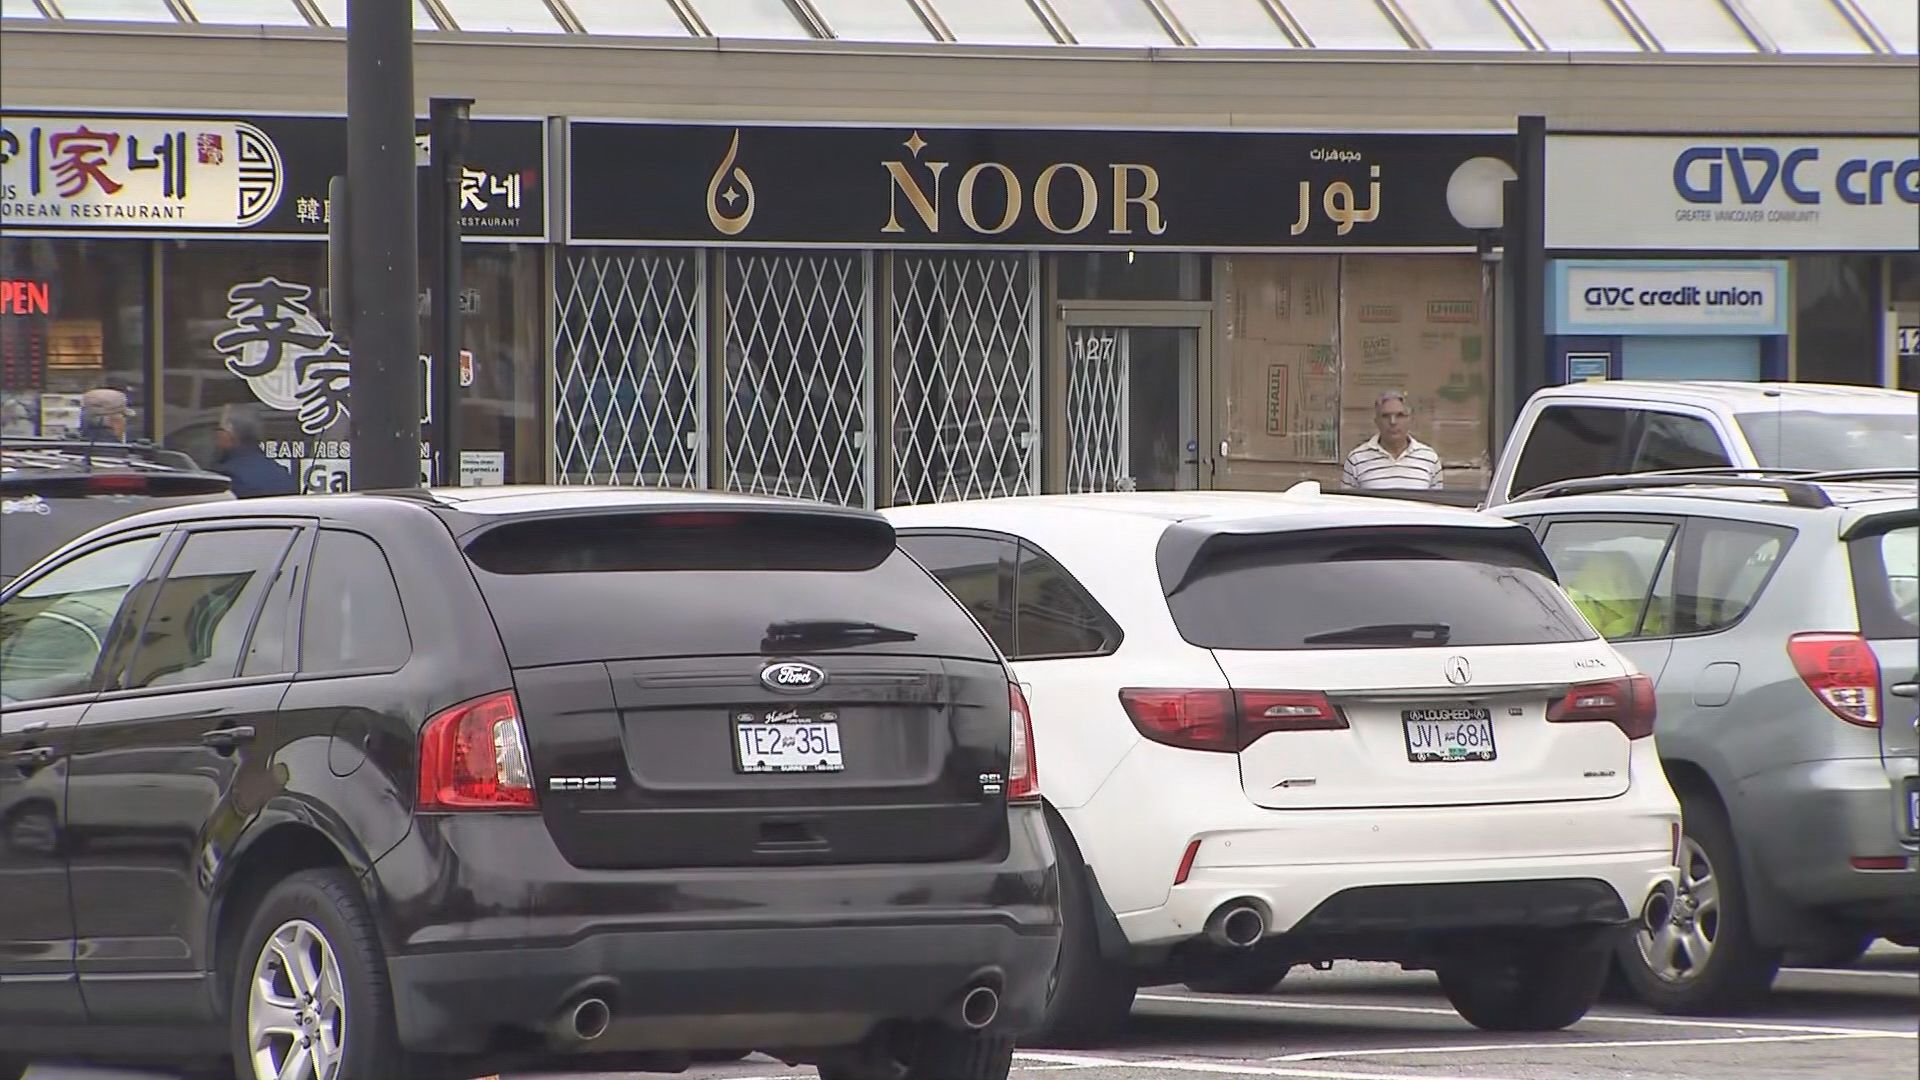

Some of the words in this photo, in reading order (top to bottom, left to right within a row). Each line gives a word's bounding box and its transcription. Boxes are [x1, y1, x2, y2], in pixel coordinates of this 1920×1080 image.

[1310, 148, 1361, 162] مجوهرات
[1673, 147, 1820, 204] GVC
[880, 161, 1168, 236] NOOR
[1290, 165, 1381, 236] نور
[70, 204, 186, 219] RESTAURANT
[296, 197, 330, 224] 韓
[1675, 209, 1712, 222] GREATER
[1715, 210, 1764, 222] VANCOUVER
[457, 217, 521, 228] ESTAURANT
[1584, 287, 1634, 306] GVC
[1639, 286, 1700, 306] credit
[1706, 286, 1763, 306] union
[1074, 337, 1114, 361] 127
[259, 440, 305, 459] EAN
[777, 666, 812, 684] Ford
[1424, 710, 1470, 720] LOUGHEED
[739, 727, 783, 755] TE2
[796, 727, 840, 754] 35L
[1412, 725, 1442, 747] JV1
[1456, 724, 1490, 747] 68A
[549, 777, 617, 790] EDGE
[979, 773, 1004, 784] SEL
